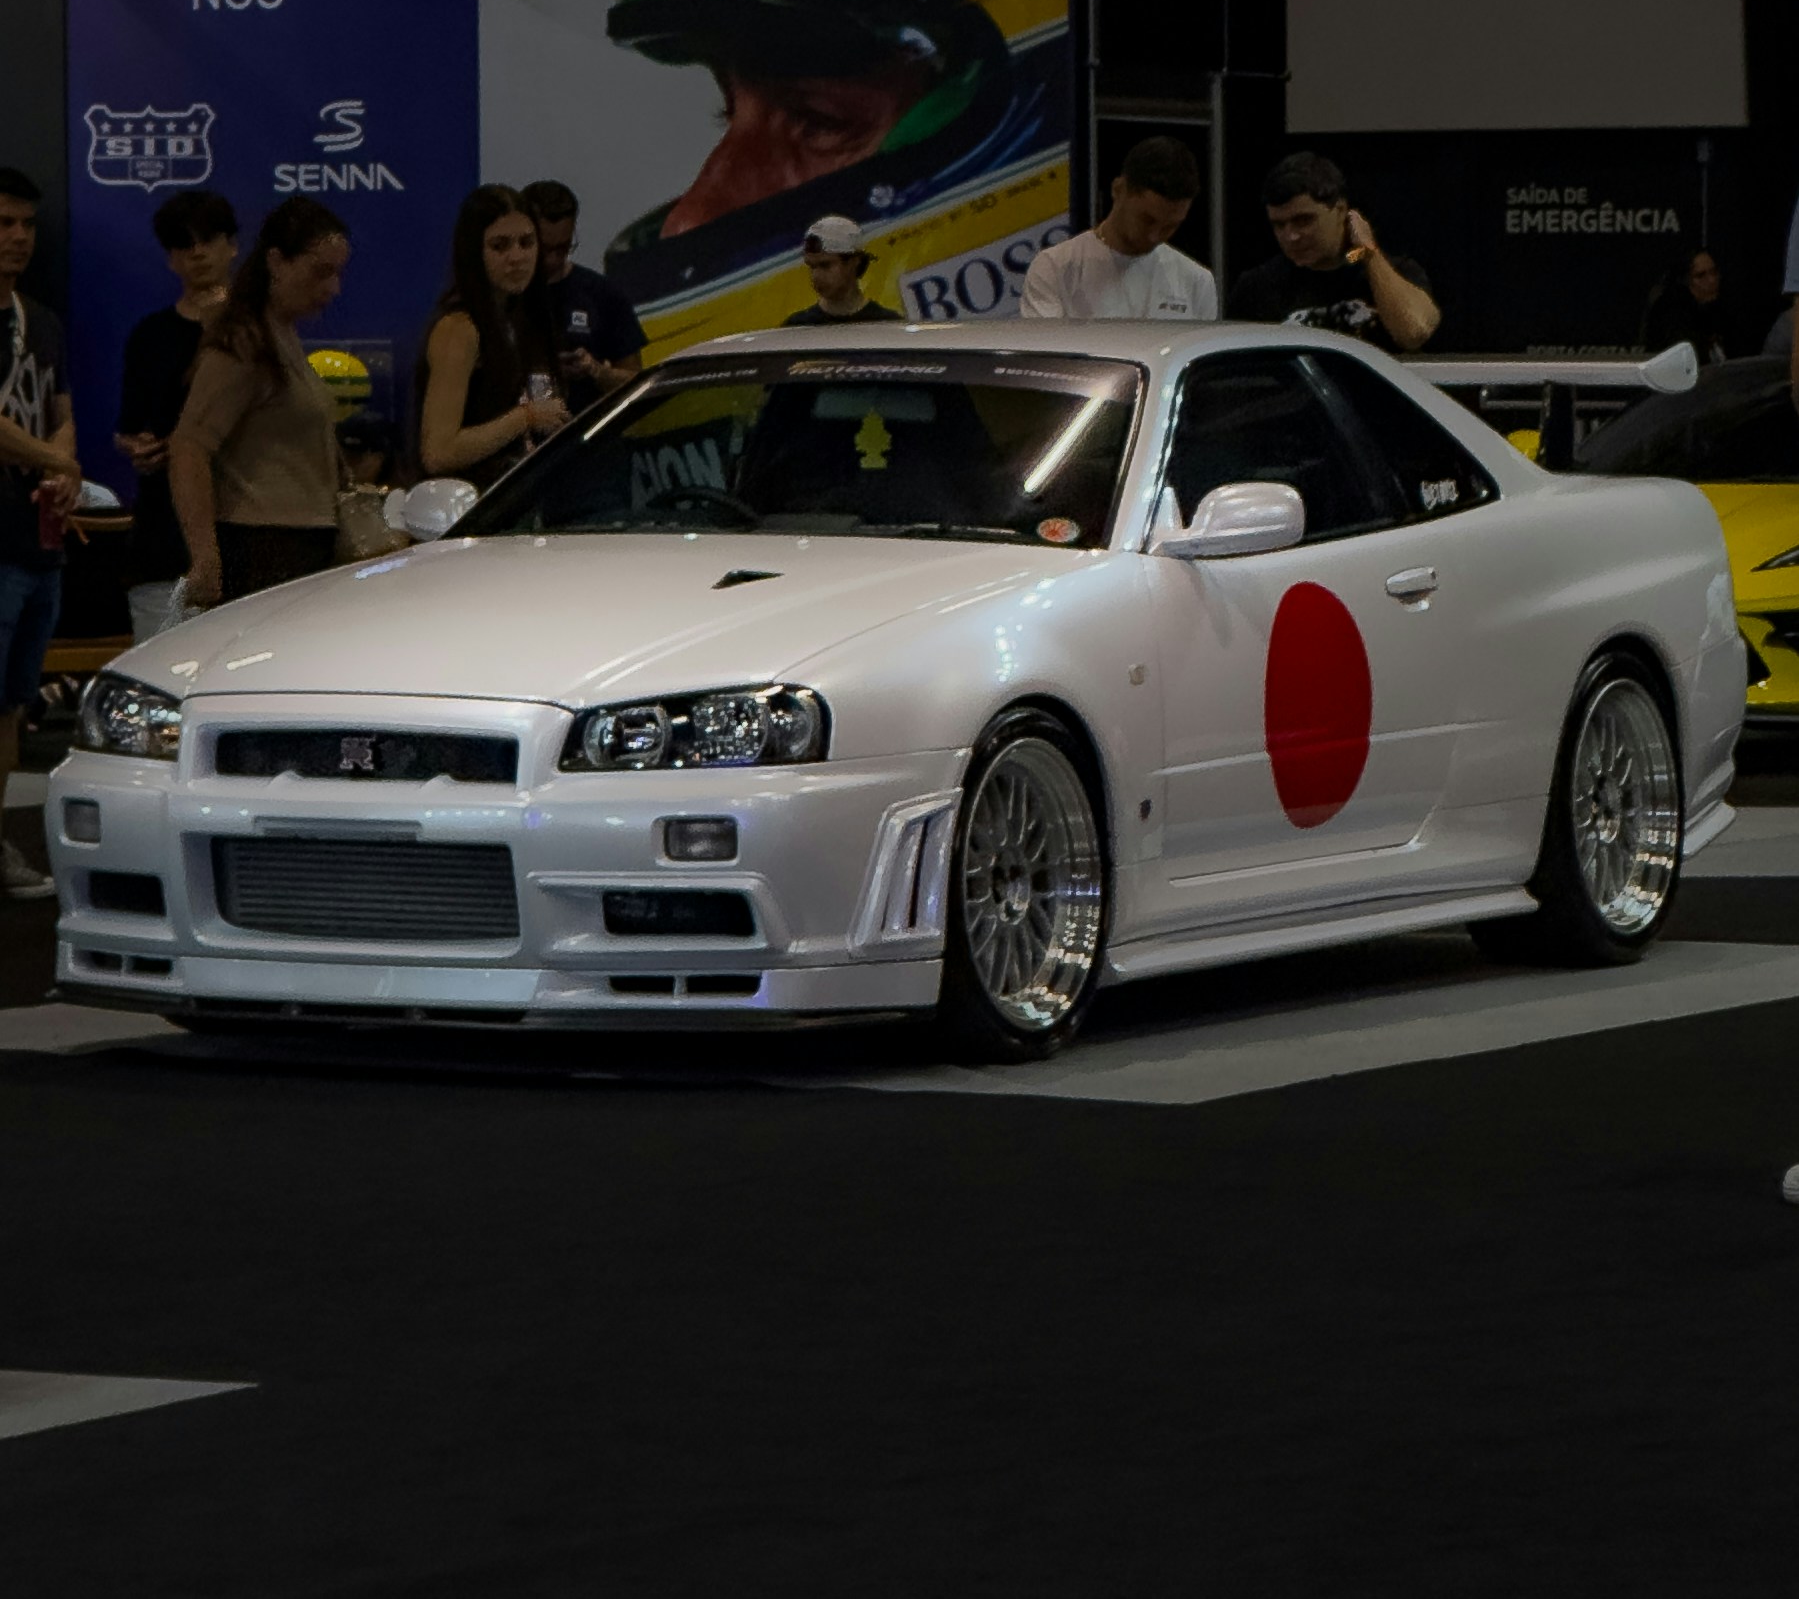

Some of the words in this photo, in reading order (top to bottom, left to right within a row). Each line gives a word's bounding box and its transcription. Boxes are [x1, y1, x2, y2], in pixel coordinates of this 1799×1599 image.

[106, 136, 194, 157] SID
[273, 162, 405, 193] SENNA
[1506, 182, 1560, 205] SAÍDA
[1563, 186, 1590, 205] DE
[1505, 198, 1681, 234] EMERGÊNCIA
